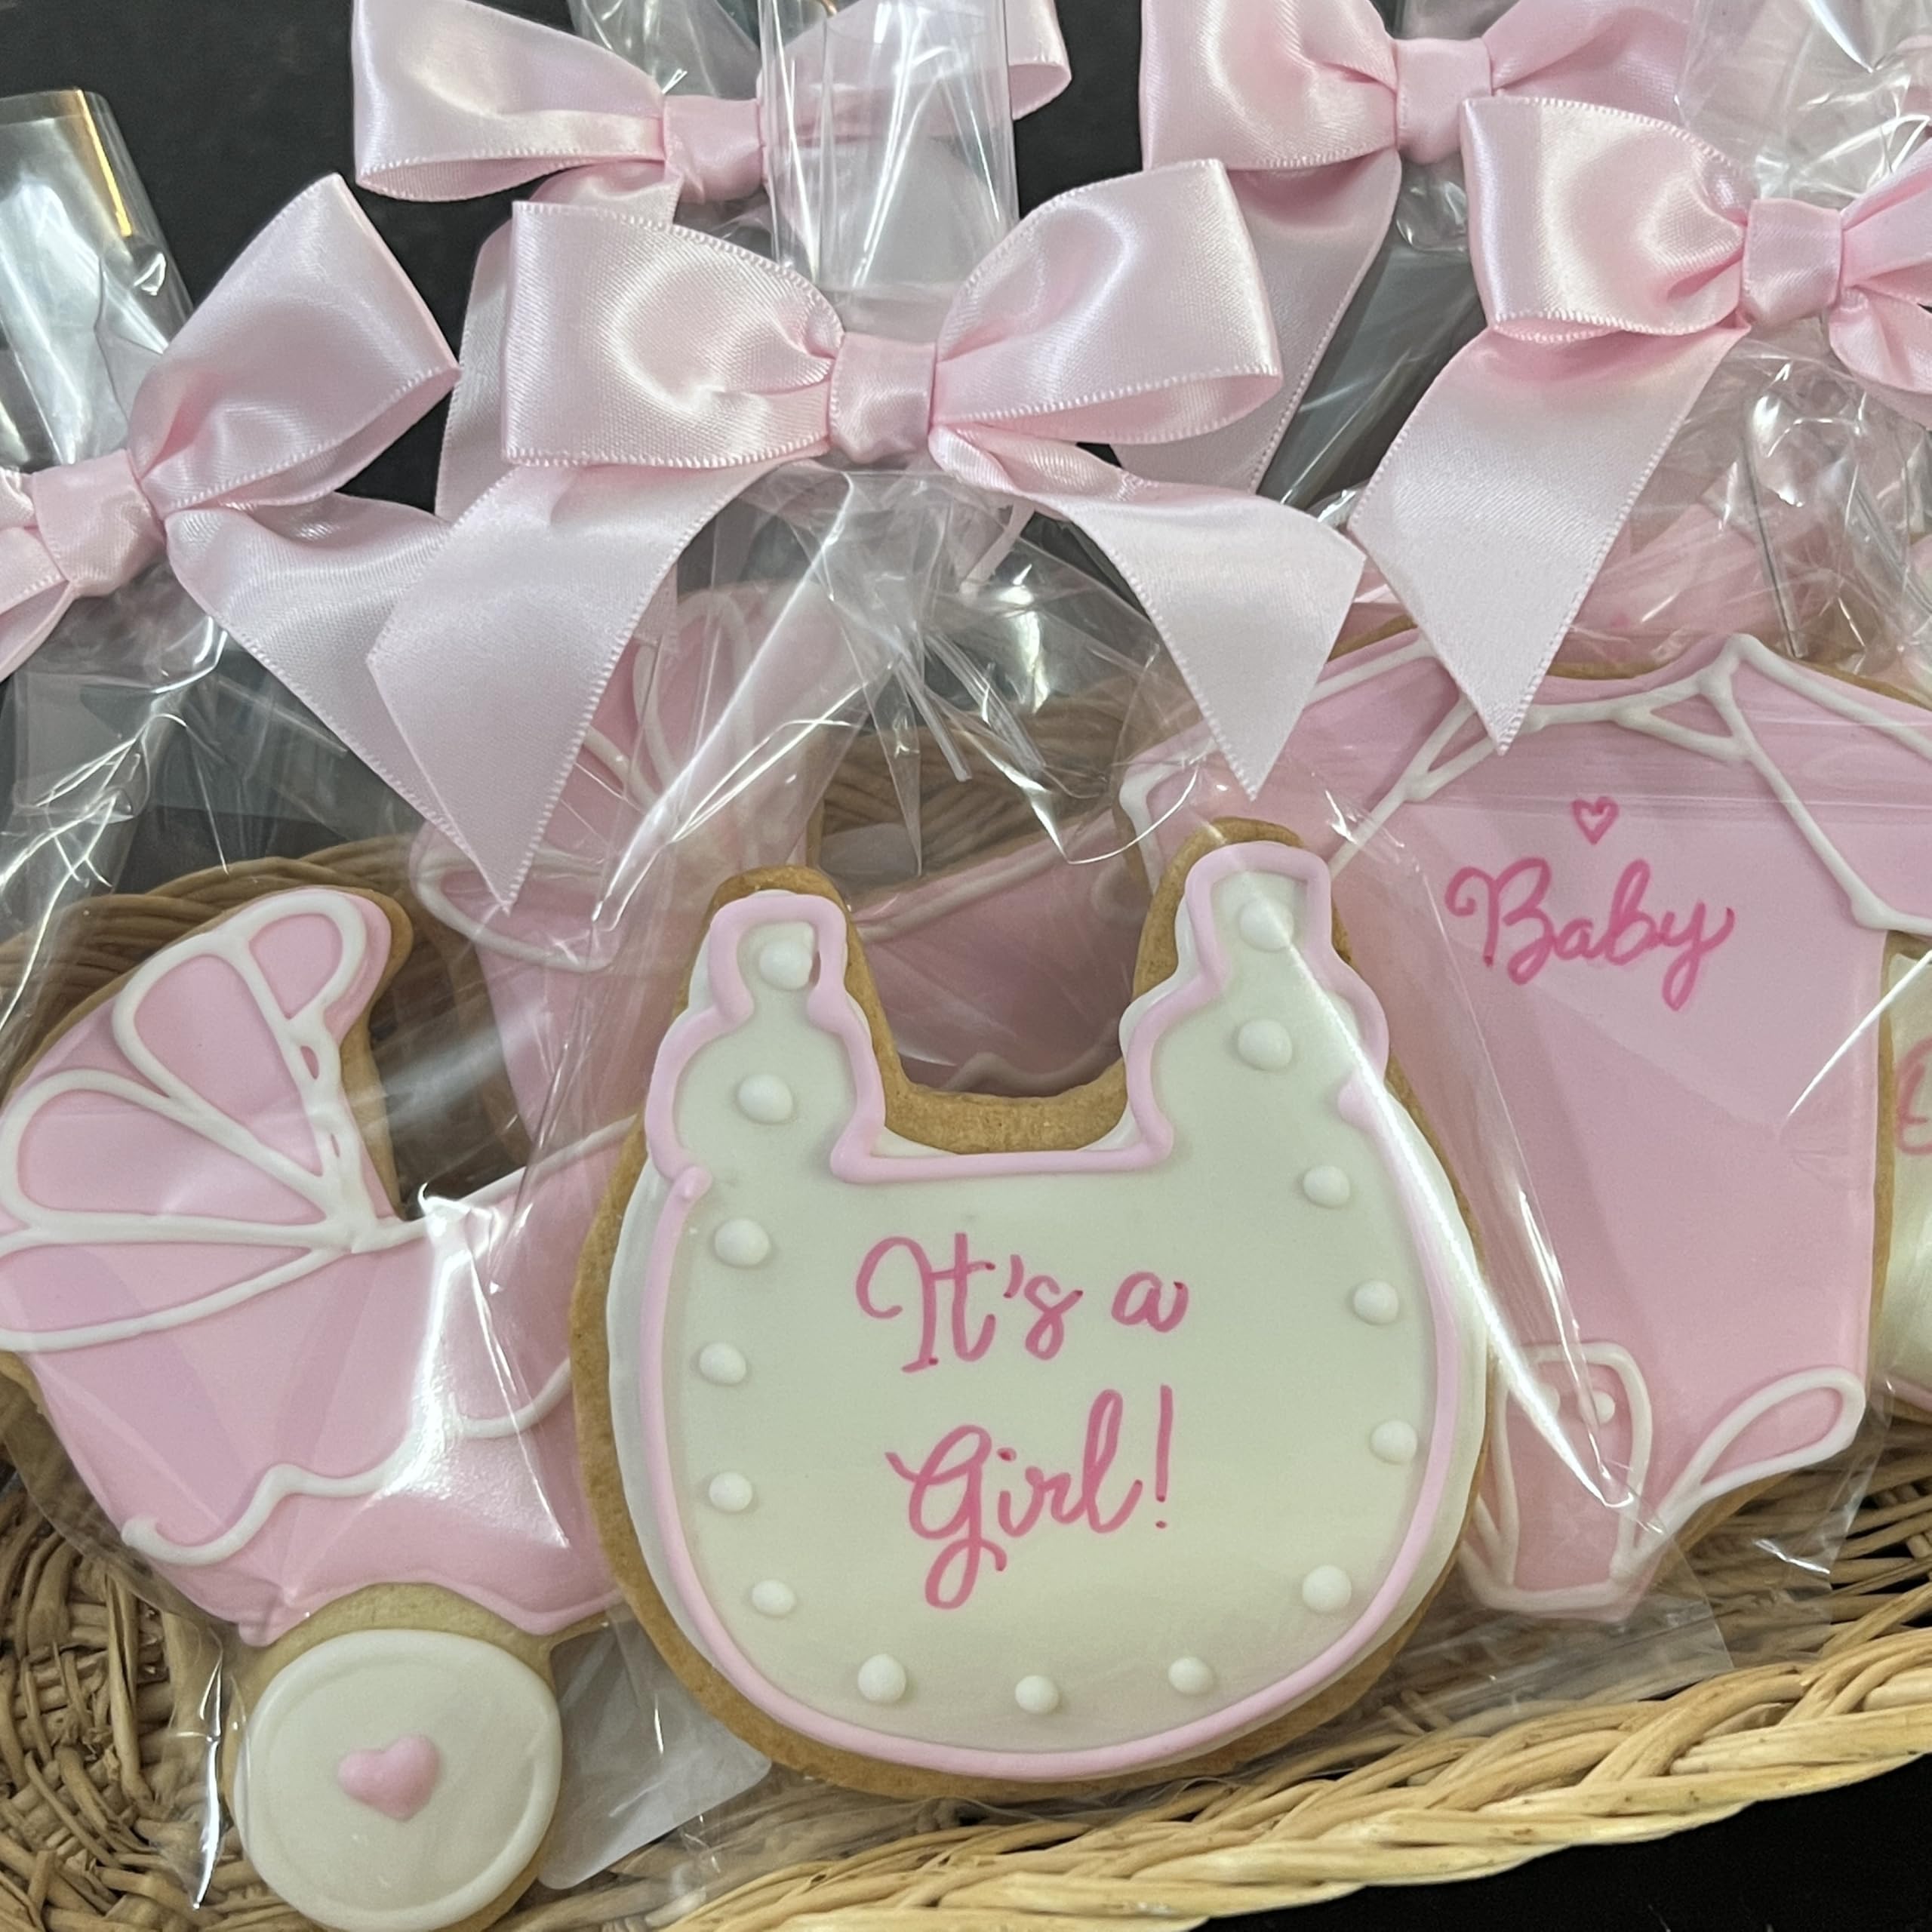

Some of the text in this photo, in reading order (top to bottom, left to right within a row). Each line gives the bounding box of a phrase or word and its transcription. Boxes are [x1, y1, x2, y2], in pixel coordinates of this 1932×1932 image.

[1444, 857, 1736, 1012] Baby
[856, 1232, 1189, 1373] It's a
[884, 1384, 1174, 1610] Girl!
